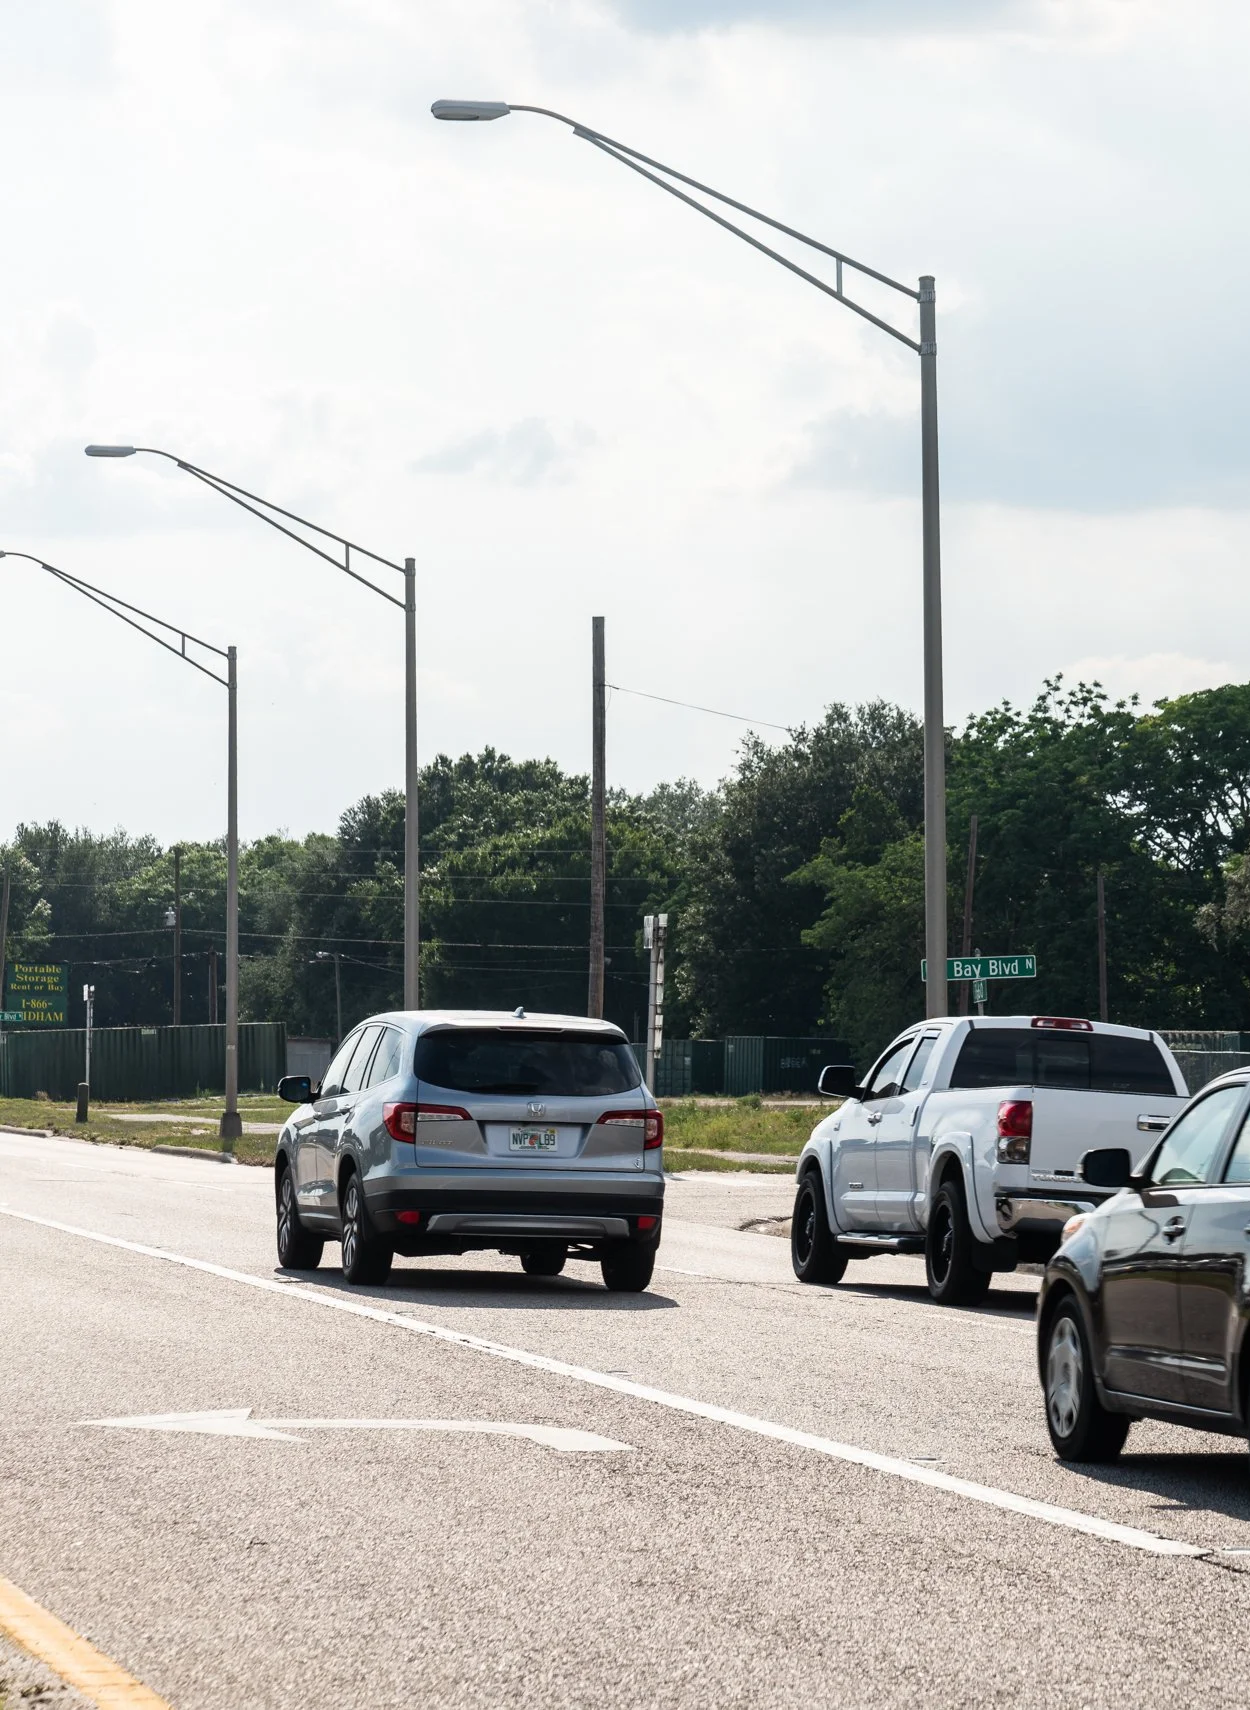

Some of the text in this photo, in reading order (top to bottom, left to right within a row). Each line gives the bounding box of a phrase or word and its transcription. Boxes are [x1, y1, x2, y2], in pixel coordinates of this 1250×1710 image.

[15, 964, 61, 973] Portable
[953, 958, 1033, 978] Bay Blvd N
[16, 974, 59, 983] Storage
[512, 1132, 529, 1145] NVP
